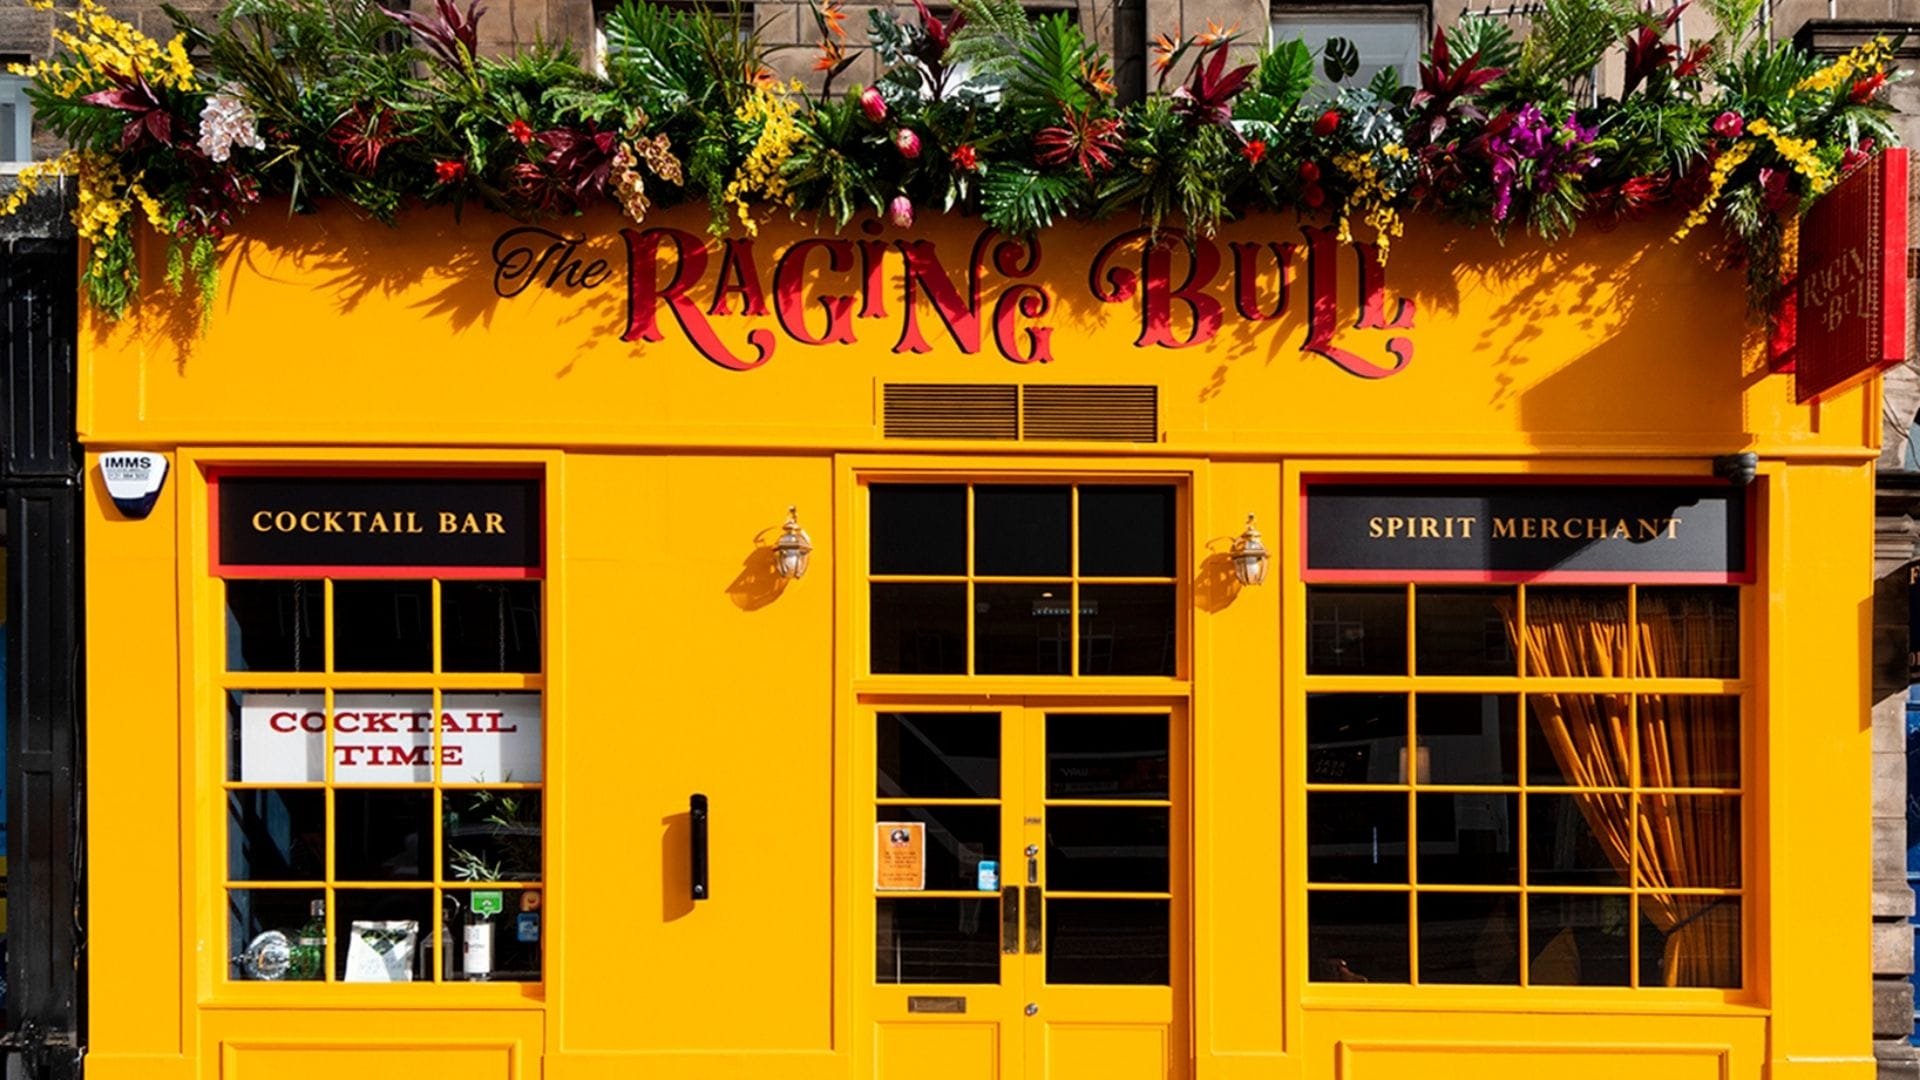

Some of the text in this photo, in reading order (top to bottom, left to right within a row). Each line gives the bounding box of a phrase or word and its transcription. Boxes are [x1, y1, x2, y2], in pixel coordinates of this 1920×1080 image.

[491, 218, 1415, 379] The RAGING BULL
[105, 456, 151, 469] IMMS
[252, 510, 506, 534] COCKTAIL BAR
[1369, 516, 1682, 540] SPIRIT MERCHANT
[269, 712, 517, 733] COCKTAIL
[333, 745, 463, 766] TIME
